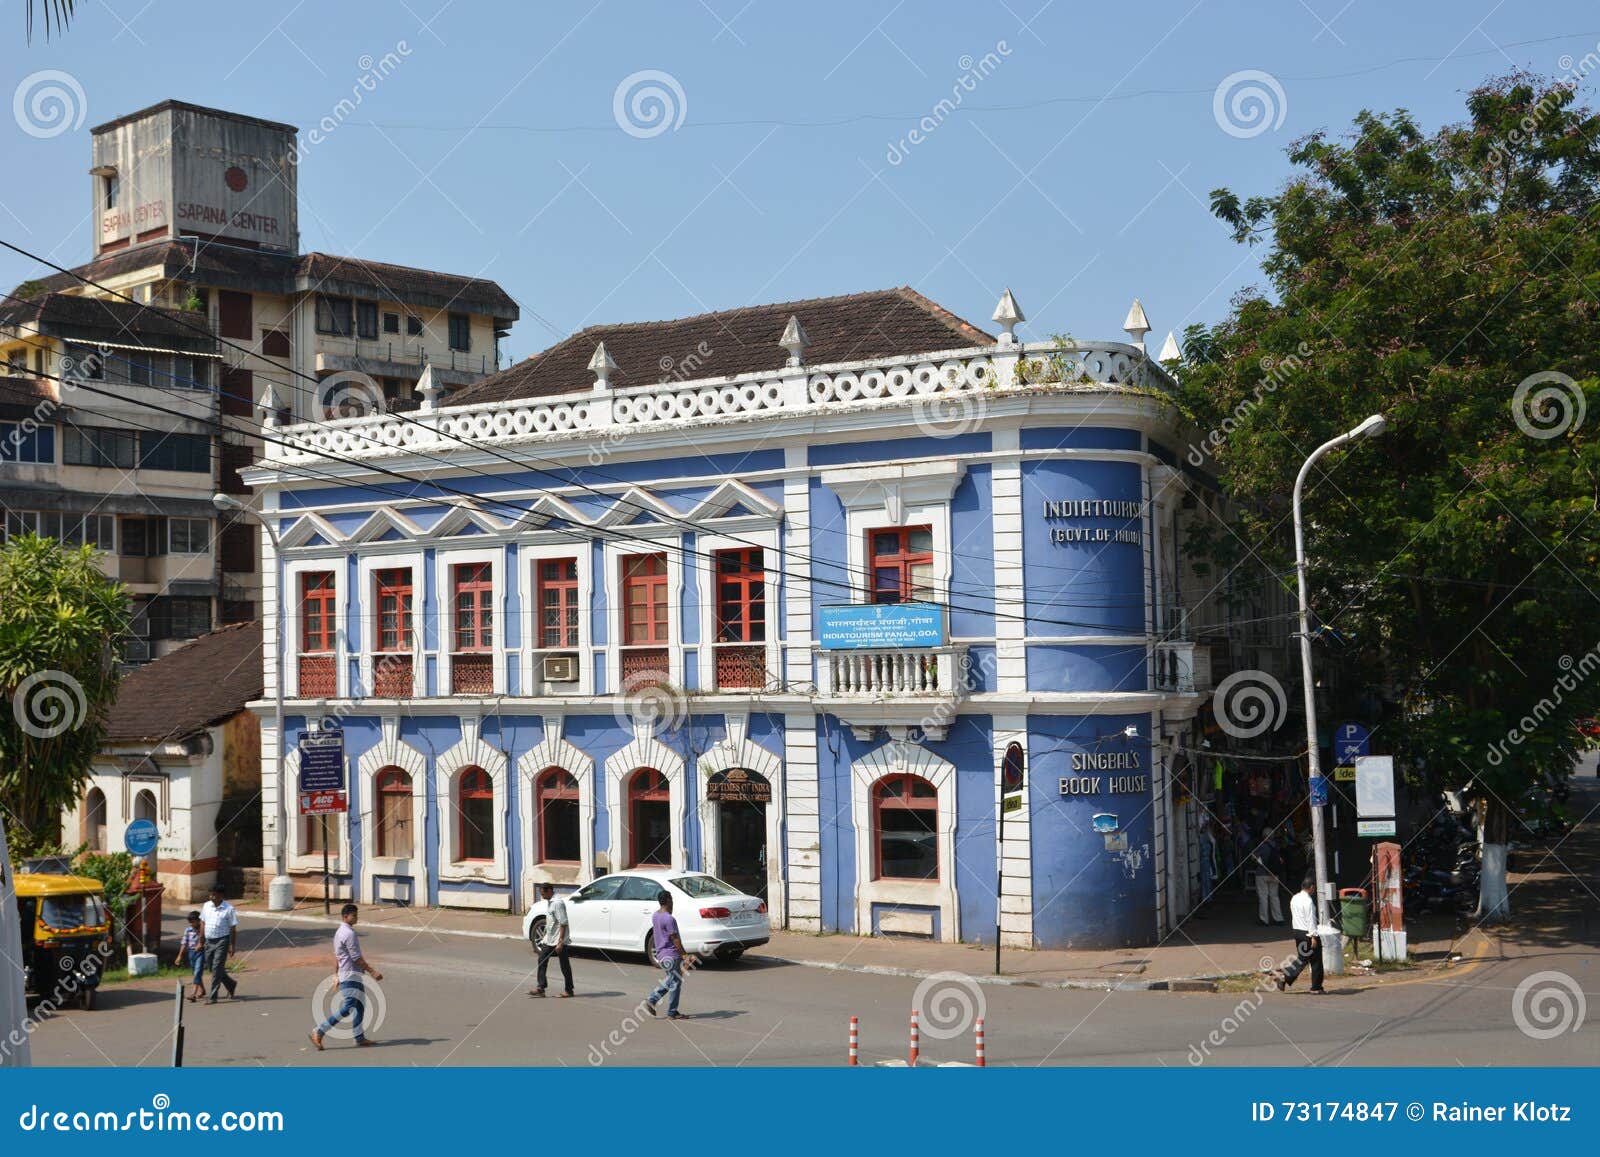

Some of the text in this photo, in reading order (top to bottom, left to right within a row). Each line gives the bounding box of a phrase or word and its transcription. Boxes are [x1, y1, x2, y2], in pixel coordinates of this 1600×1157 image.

[103, 200, 165, 234] SAPANA CENTER
[178, 203, 280, 236] SAPANA CENTER
[823, 631, 883, 640] INDIATOURISM
[1346, 725, 1358, 739] P
[1071, 750, 1140, 770] SINGBAL'S
[720, 782, 740, 792] TIMES
[751, 783, 770, 793] INDIA
[1058, 775, 1147, 795] BOOK HOUSE
